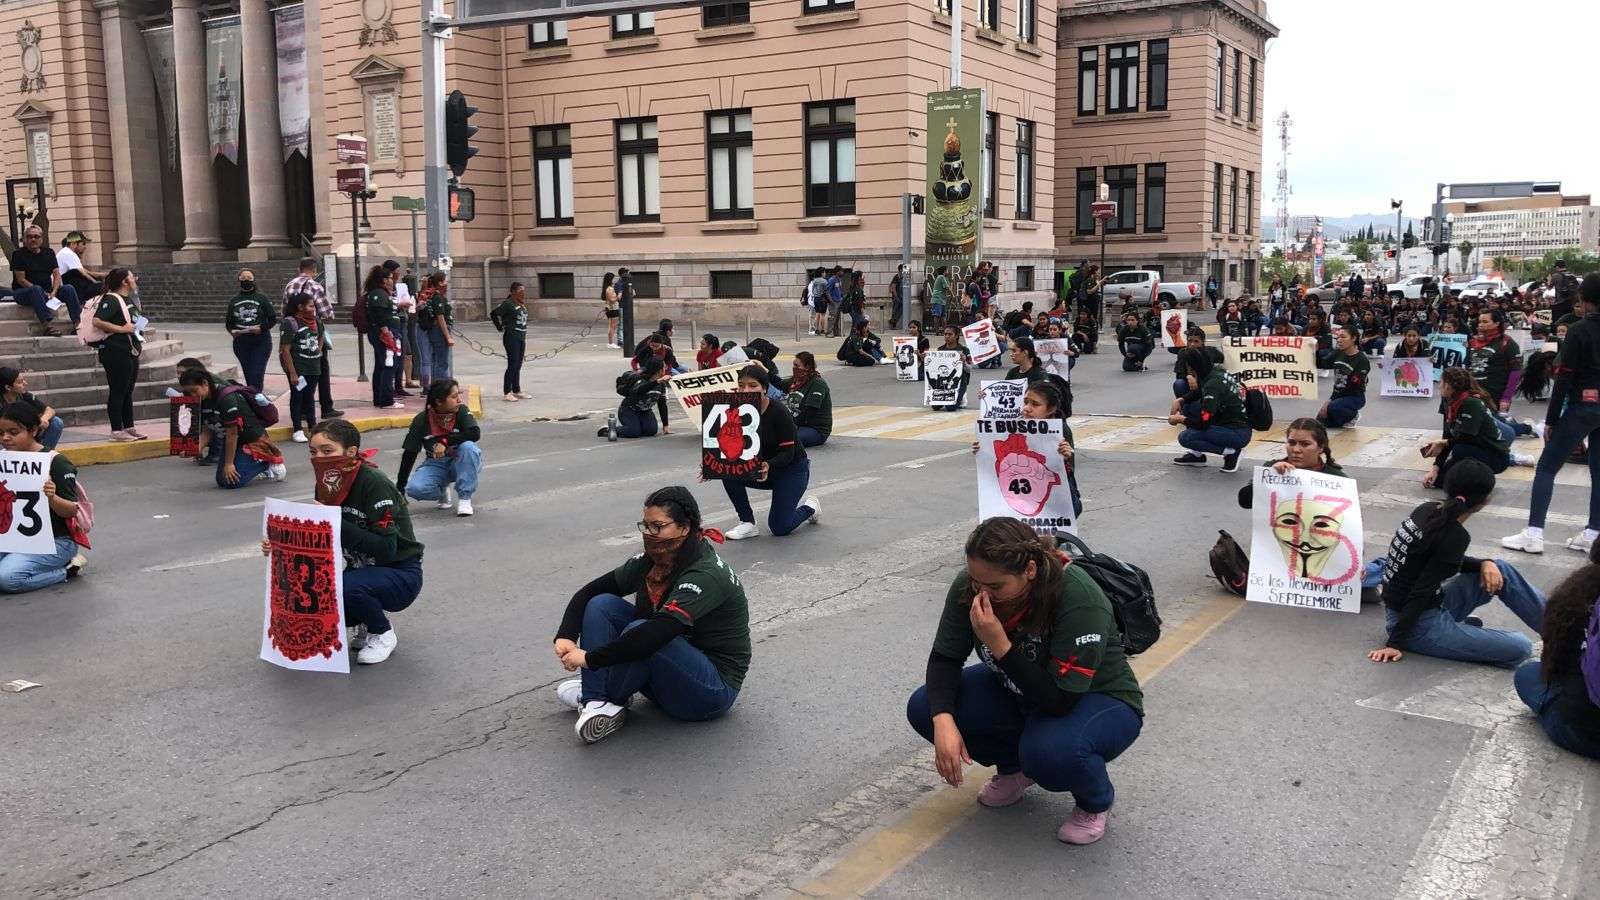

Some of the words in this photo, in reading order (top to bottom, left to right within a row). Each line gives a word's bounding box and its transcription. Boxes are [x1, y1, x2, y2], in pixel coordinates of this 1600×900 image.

[1231, 337, 1247, 347] EL
[1253, 337, 1303, 349] PUEBLO
[1240, 352, 1298, 364] MIRANDO,
[673, 371, 734, 390] RESPETO
[1233, 367, 1277, 383] AMBIÉN
[1283, 370, 1314, 383] ESTÁ
[998, 396, 1016, 409] 43
[702, 403, 761, 461] 43
[977, 420, 992, 433] TE
[996, 420, 1060, 434] BUSCO...
[1008, 478, 1032, 495] 43
[1021, 516, 1071, 527] CORAZÓN
[1269, 491, 1360, 586] 43
[1337, 584, 1354, 596] en
[1268, 588, 1344, 609] SEPTIEMBRE
[1075, 633, 1102, 647] FECSM
